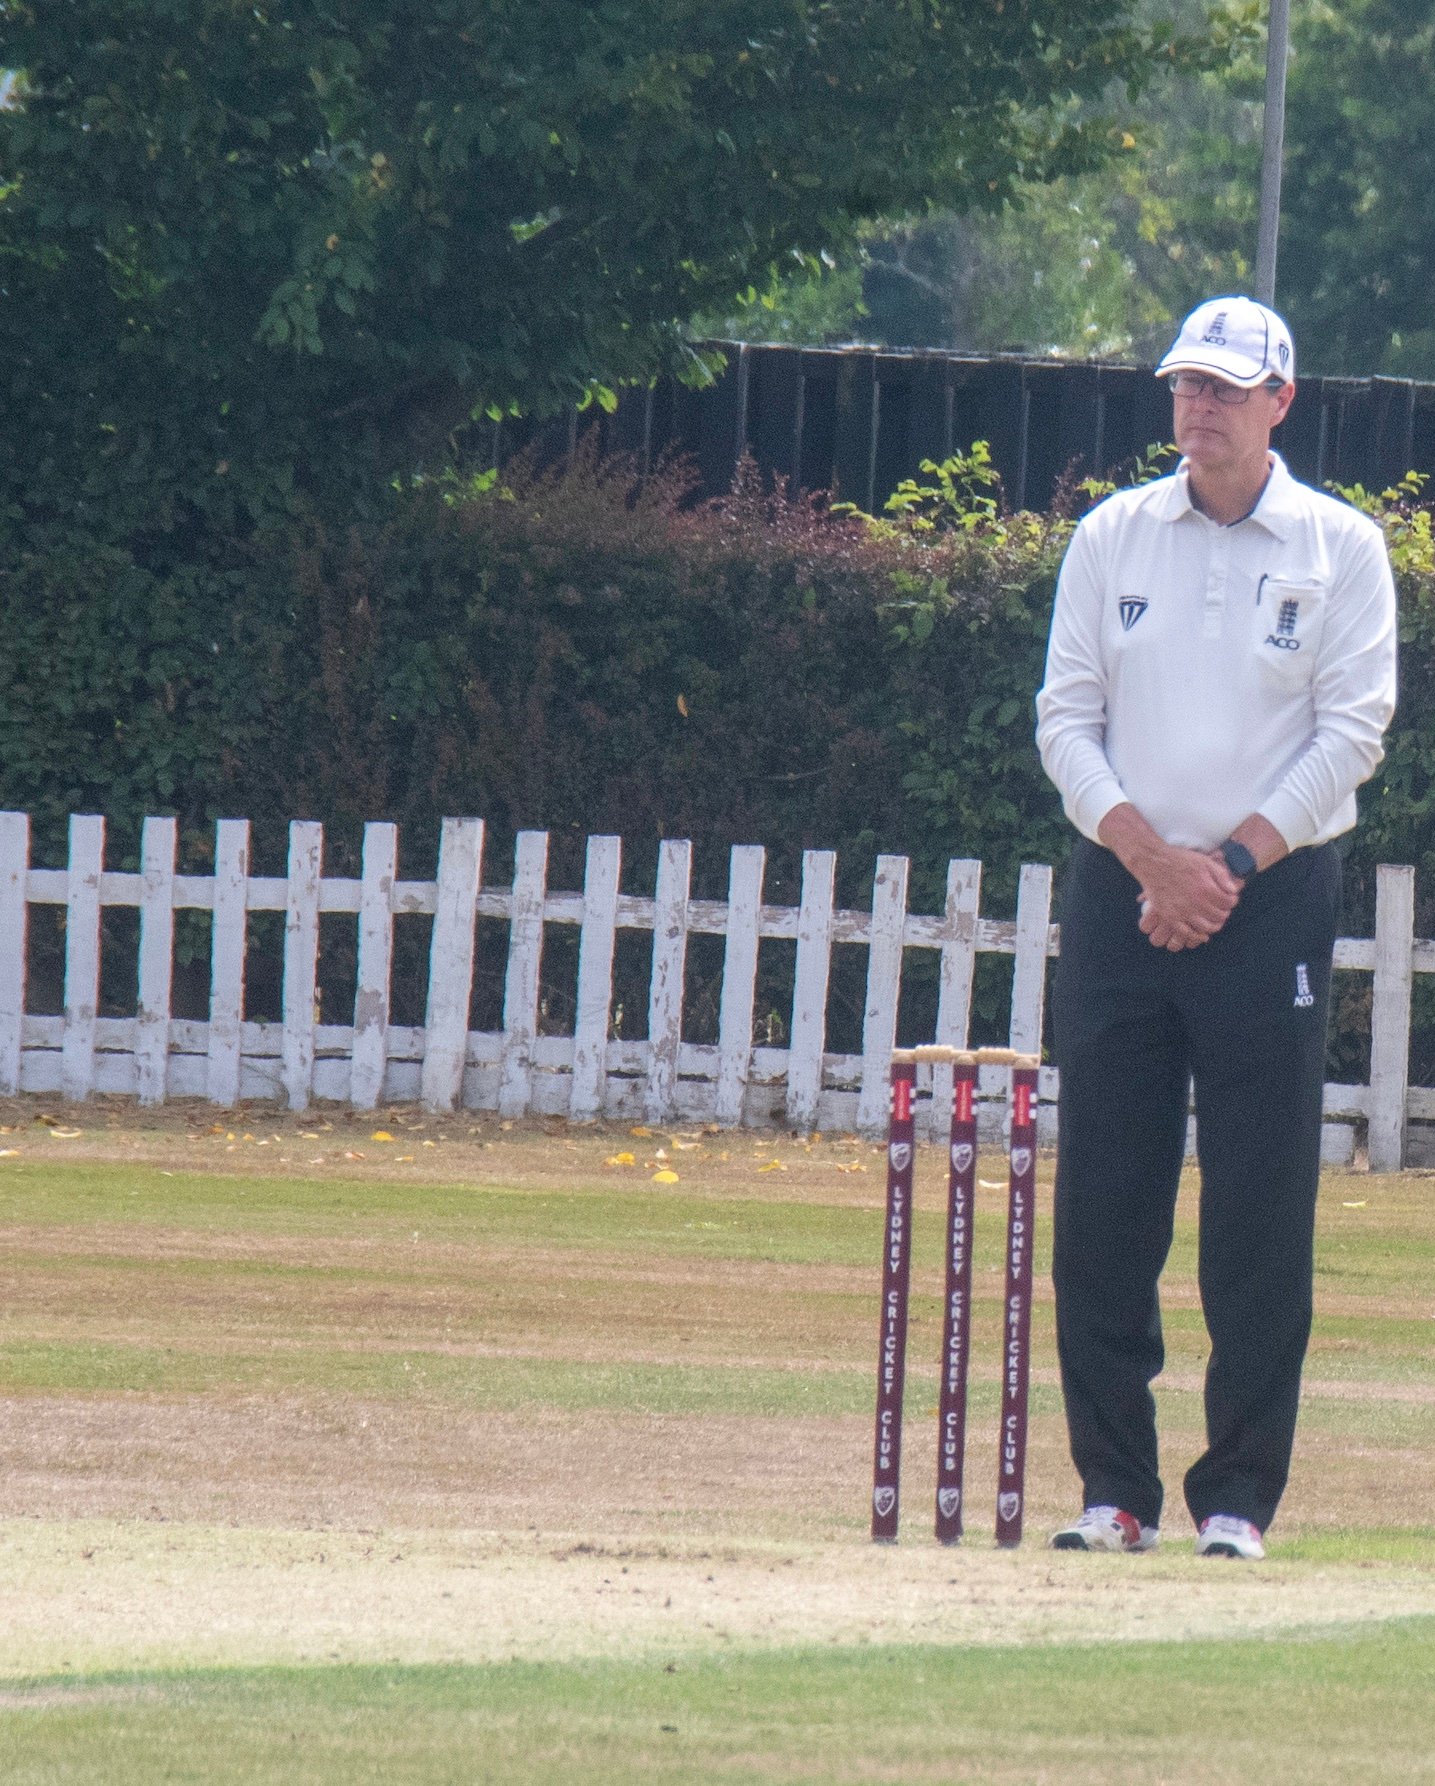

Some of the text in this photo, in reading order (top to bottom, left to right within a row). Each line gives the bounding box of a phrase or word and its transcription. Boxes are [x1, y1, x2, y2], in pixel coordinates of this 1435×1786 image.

[1202, 335, 1226, 346] ACO
[1264, 635, 1300, 651] ACO
[879, 1186, 903, 1469] LYDNEY CRICKET CLUB
[944, 1186, 965, 1471] LYDNEY CRICKET CLUB
[1005, 1191, 1024, 1475] LYDNEY CRICKET CLUB
